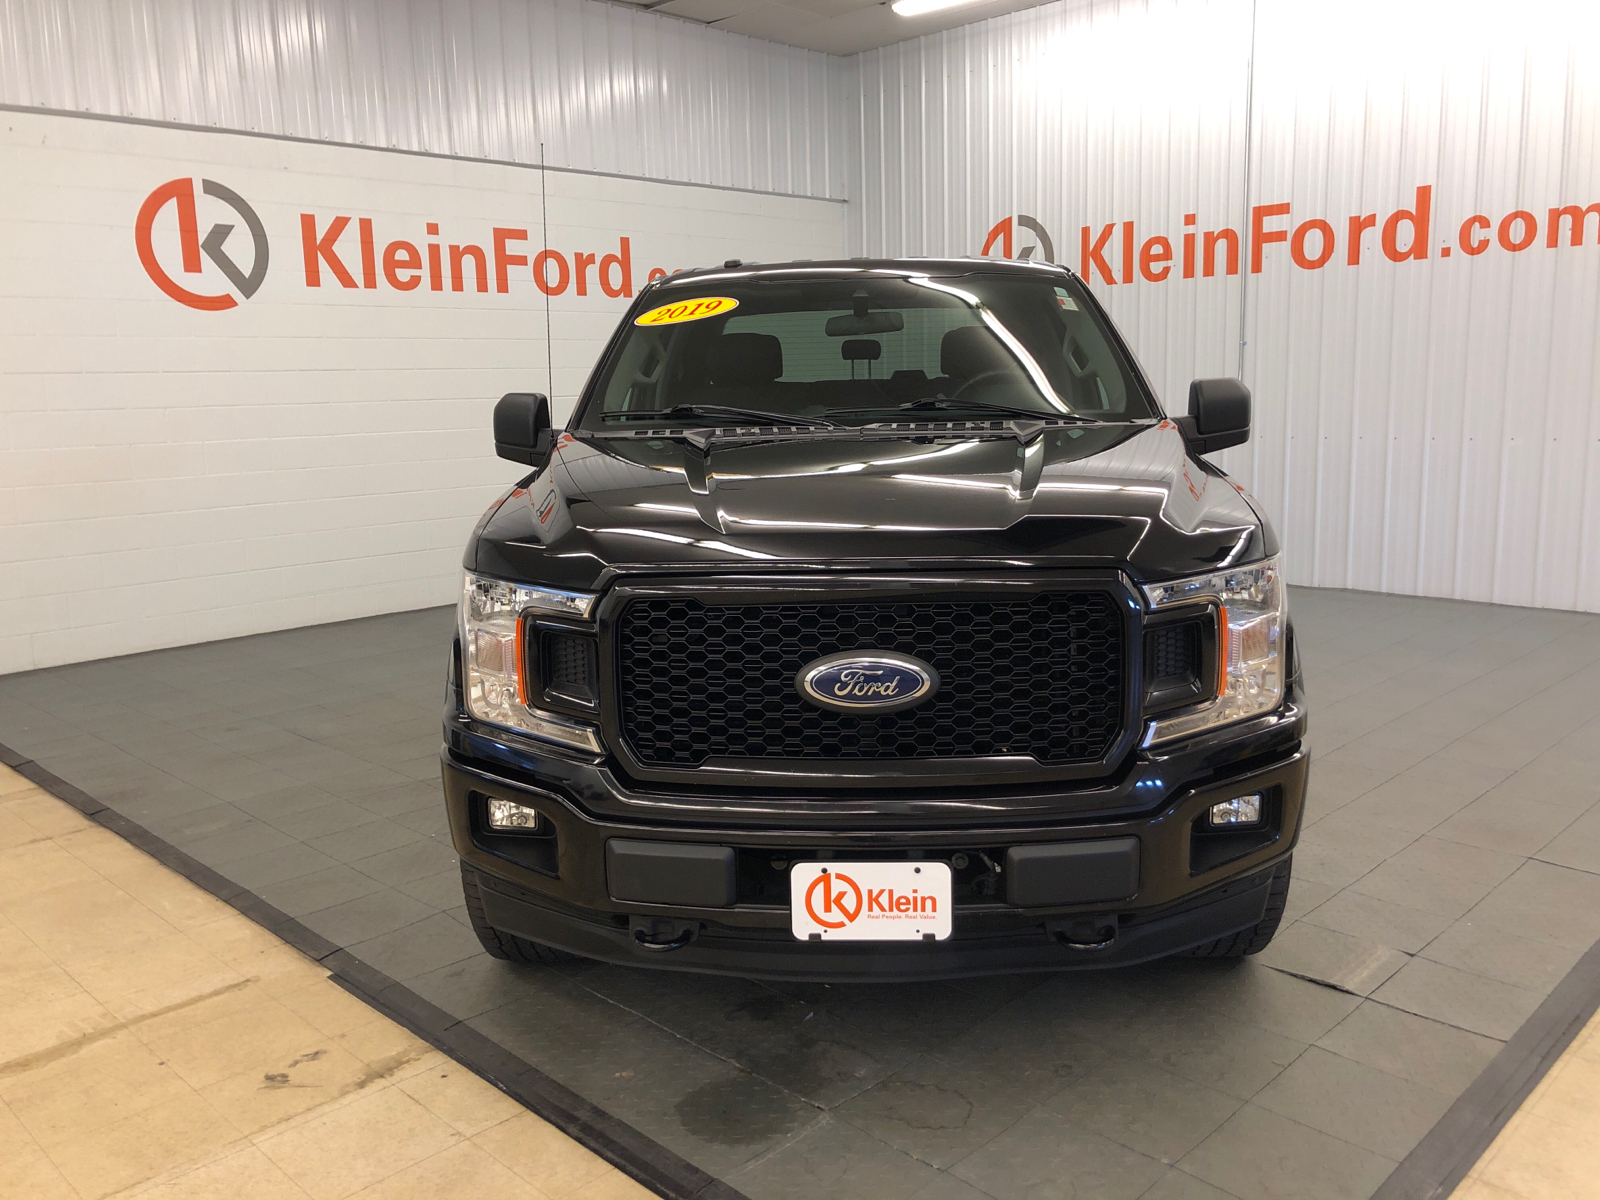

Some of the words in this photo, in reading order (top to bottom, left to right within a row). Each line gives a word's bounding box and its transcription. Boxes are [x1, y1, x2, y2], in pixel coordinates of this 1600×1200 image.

[299, 213, 683, 298] KleinFord
[650, 300, 723, 323] 2019
[834, 669, 900, 696] Ford
[867, 888, 937, 913] Klein
[882, 913, 903, 921] People.
